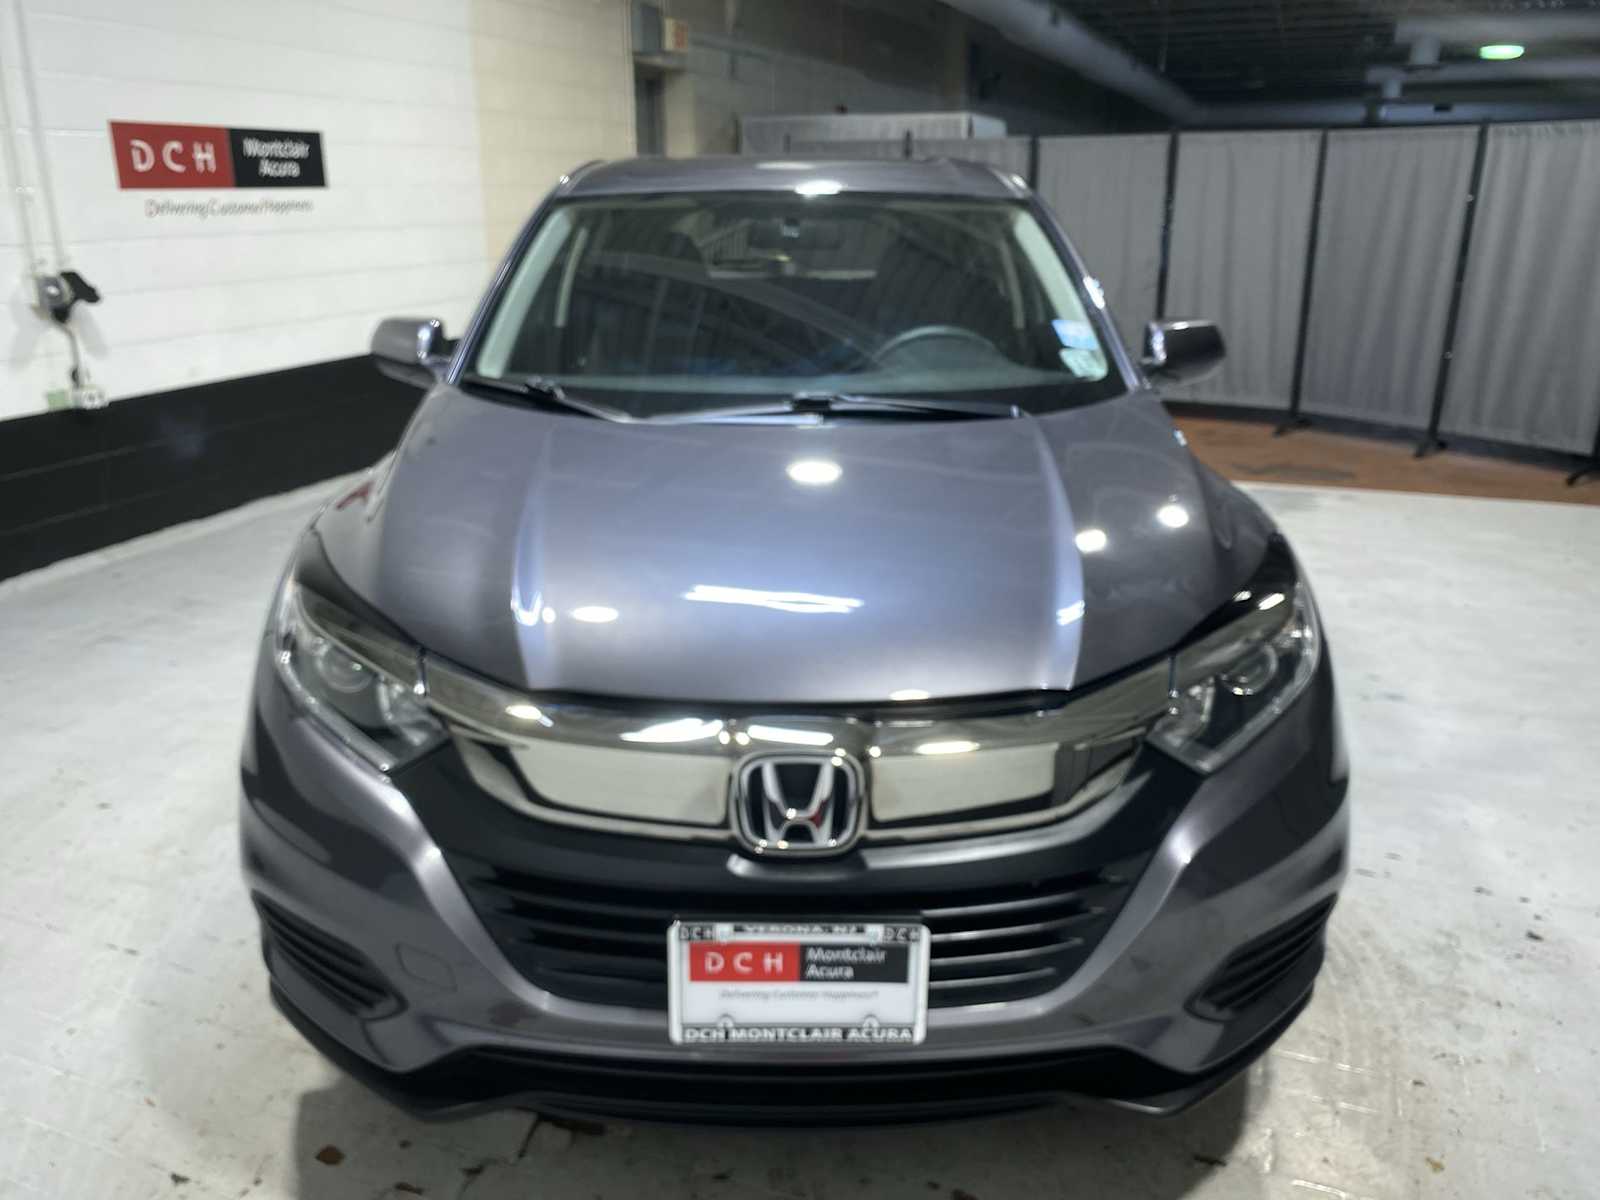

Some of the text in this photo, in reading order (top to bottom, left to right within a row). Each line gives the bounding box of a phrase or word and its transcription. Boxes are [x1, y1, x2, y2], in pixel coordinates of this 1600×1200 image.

[129, 139, 217, 173] DCH
[258, 159, 300, 177] Acura
[704, 951, 784, 974] DCH
[806, 947, 886, 964] Montclair
[805, 964, 854, 979] Acura
[685, 1027, 912, 1041] DCH MONTCLAIR ACURA
